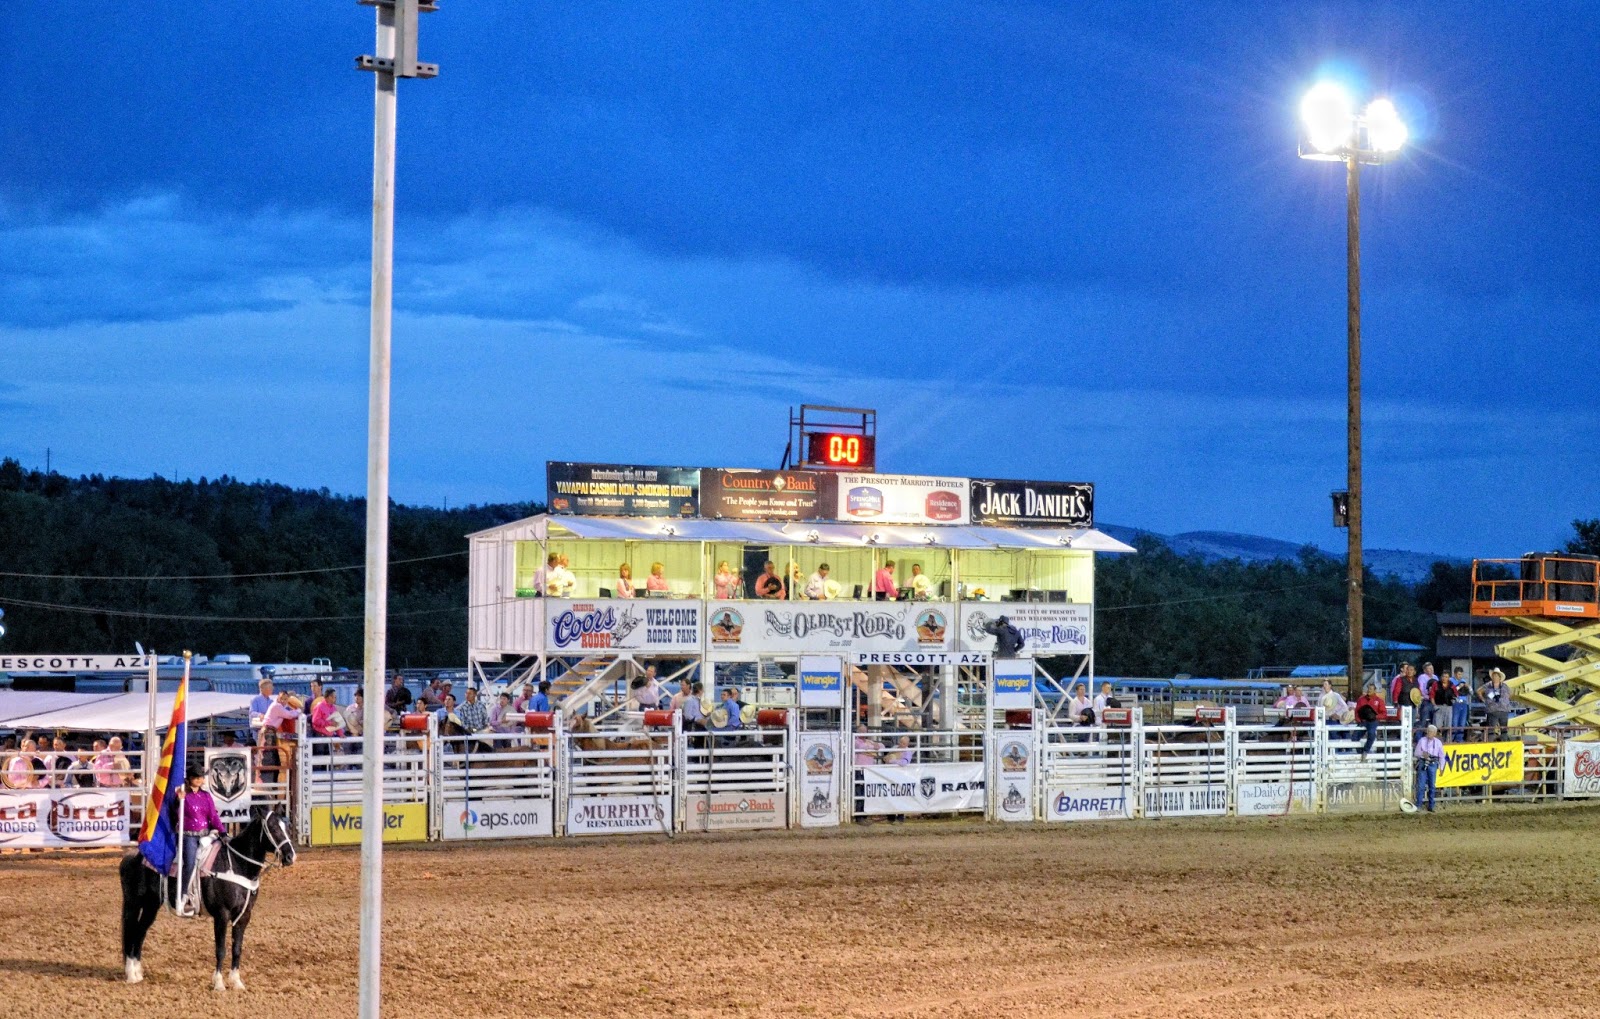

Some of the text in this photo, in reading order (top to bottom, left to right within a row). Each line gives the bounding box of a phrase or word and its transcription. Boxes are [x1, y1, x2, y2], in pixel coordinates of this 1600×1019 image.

[556, 482, 692, 498] YAVAPAI CASINO NON-SMOKING ROOM
[722, 474, 816, 491] Country Bank
[860, 477, 898, 485] PRESCOTT
[900, 478, 934, 486] MARRIOTT
[936, 480, 964, 488] HOTELS
[738, 496, 758, 507] People
[769, 498, 785, 506] Know
[786, 498, 797, 506] and
[980, 486, 1086, 518] JACK DANIEL'S
[572, 604, 594, 612] ORIGINAL
[646, 608, 697, 626] WELCOME
[552, 606, 617, 648] Coors
[794, 612, 853, 638] OLDEST
[852, 611, 906, 640] RODEO
[581, 633, 611, 648] RODEO
[646, 629, 697, 644] RODEO FANS
[1052, 625, 1086, 645] RODEO
[114, 657, 141, 667] AZ
[859, 654, 980, 664] PRESCOTT, AZ
[802, 674, 839, 688] Wrangler
[996, 678, 1030, 691] Wrangler
[1443, 748, 1512, 780] Wrangler
[942, 781, 985, 792] RAM
[1254, 786, 1278, 800] Daily
[1190, 790, 1226, 810] RANCHES
[1329, 786, 1356, 804] JACK
[696, 798, 775, 812] Cuntry Bank
[1058, 796, 1126, 812] BARRETT
[216, 808, 248, 817] AM
[574, 804, 664, 823] MURPHY'S
[332, 812, 404, 834] Wraler
[480, 811, 538, 830] aps.com
[586, 818, 654, 828] RESTAURANT
